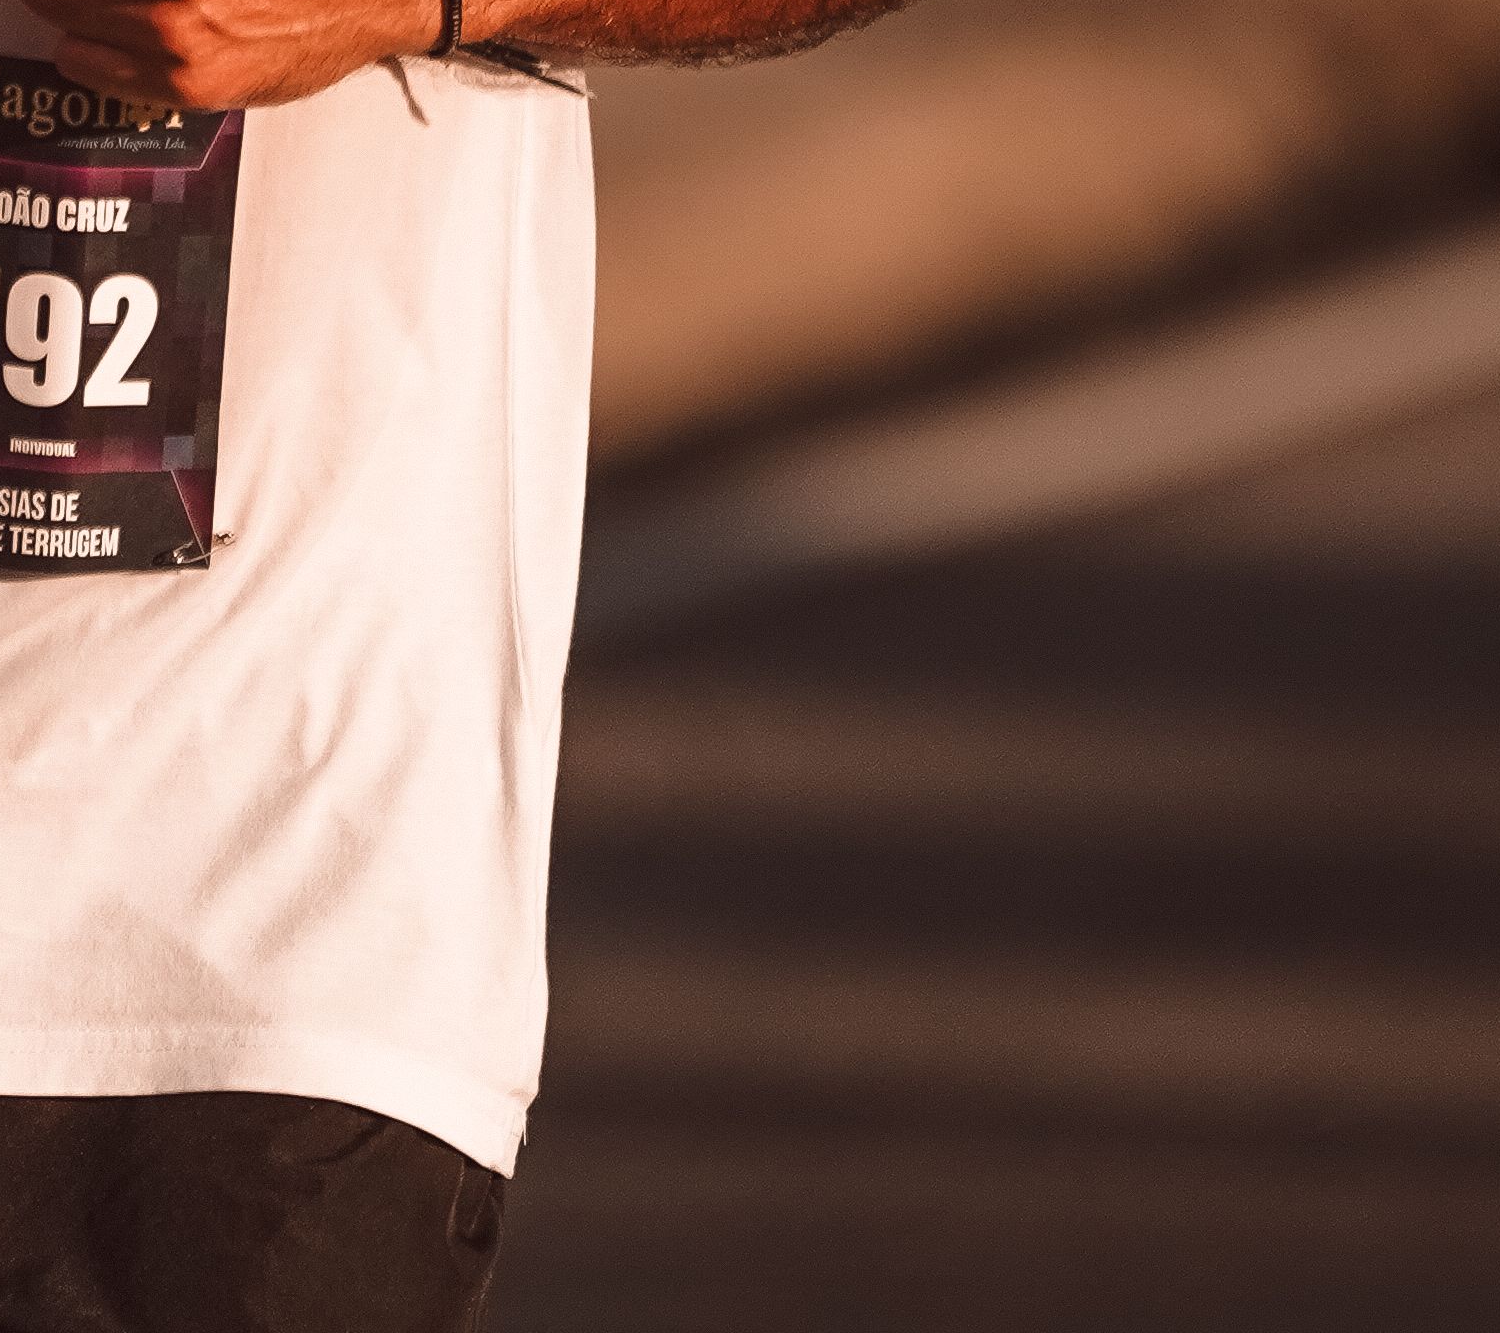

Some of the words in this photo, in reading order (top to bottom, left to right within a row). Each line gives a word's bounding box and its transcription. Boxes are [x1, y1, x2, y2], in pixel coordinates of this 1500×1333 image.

[56, 197, 131, 232] CRUZ
[9, 436, 78, 458] INDIVIDUAL
[50, 490, 81, 522] DE
[9, 526, 121, 558] TERRUGEM
